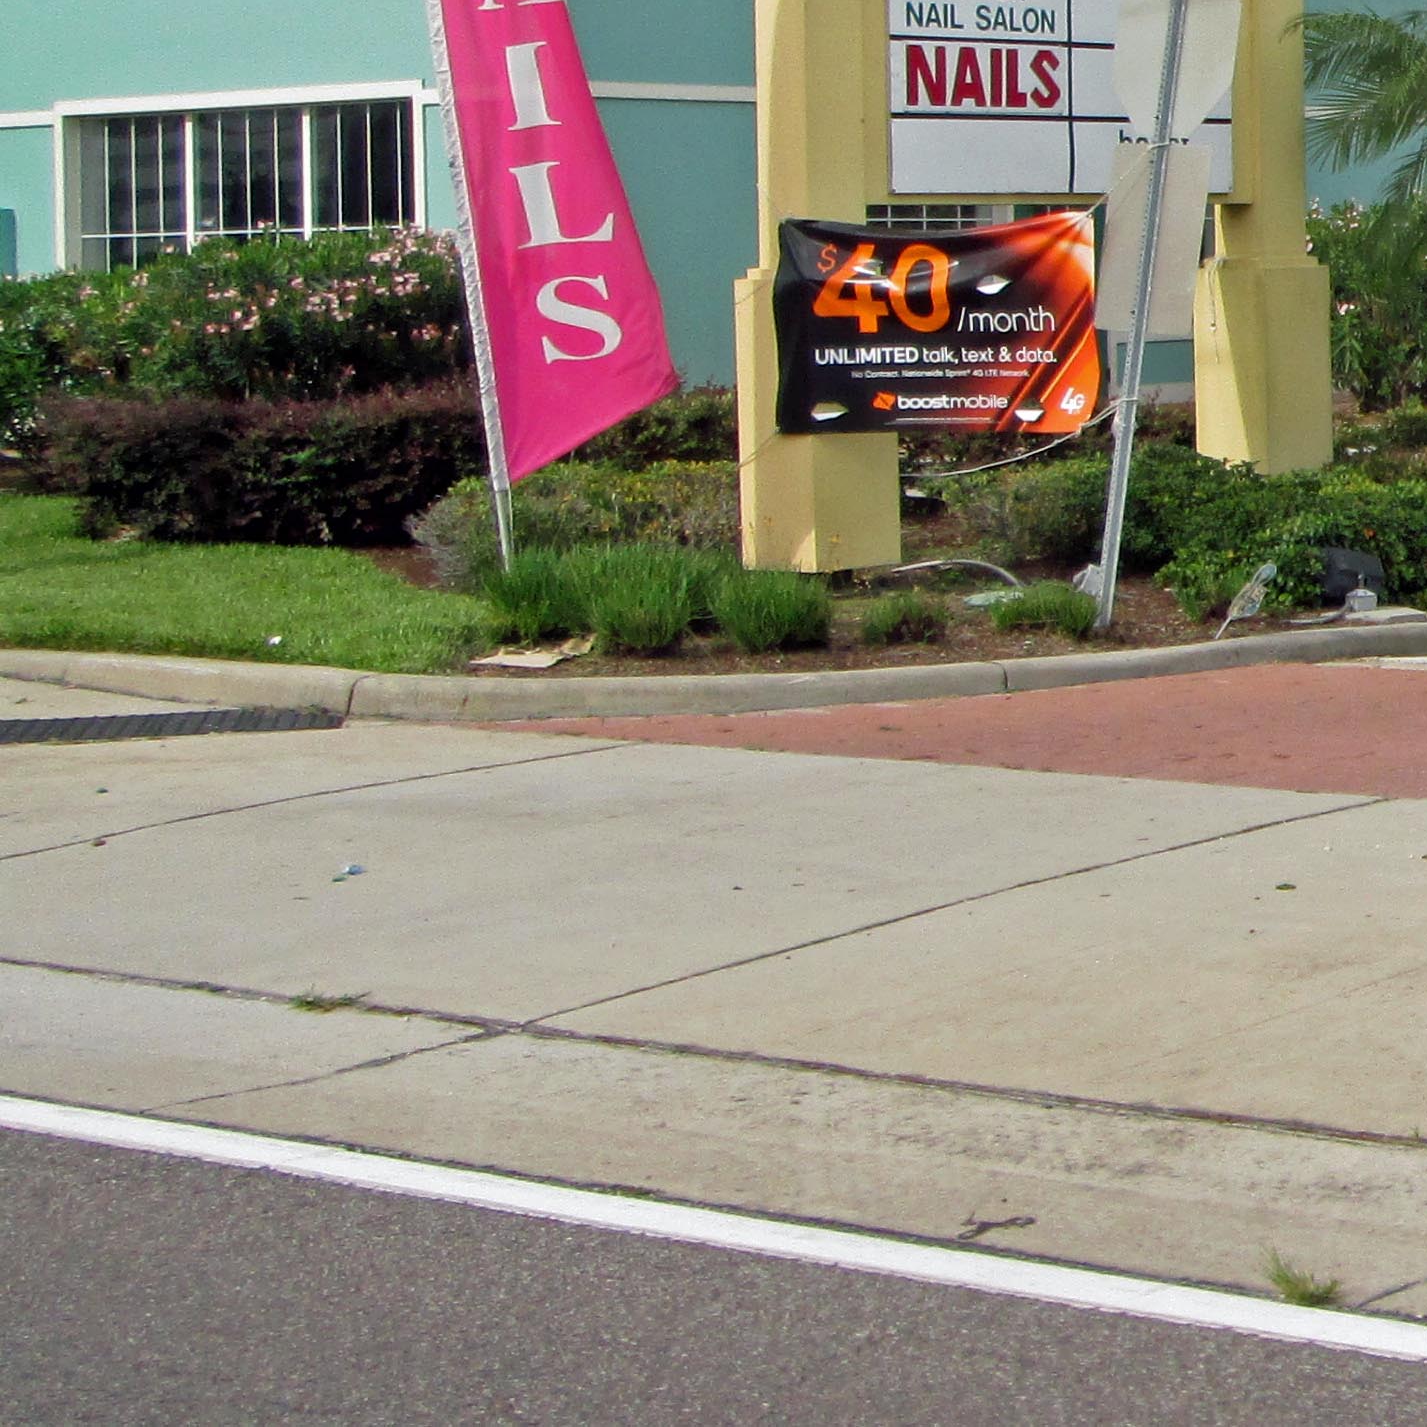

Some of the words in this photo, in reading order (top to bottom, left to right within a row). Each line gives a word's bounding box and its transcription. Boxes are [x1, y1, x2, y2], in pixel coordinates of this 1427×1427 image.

[905, 2, 963, 30] NAIL
[975, 5, 1056, 34] SALON
[906, 44, 1061, 109] NAILS
[815, 347, 919, 364] UNLIMITED
[923, 347, 959, 365] talk,
[961, 347, 994, 363] text
[999, 347, 1012, 362] &
[1060, 387, 1086, 415] 4G
